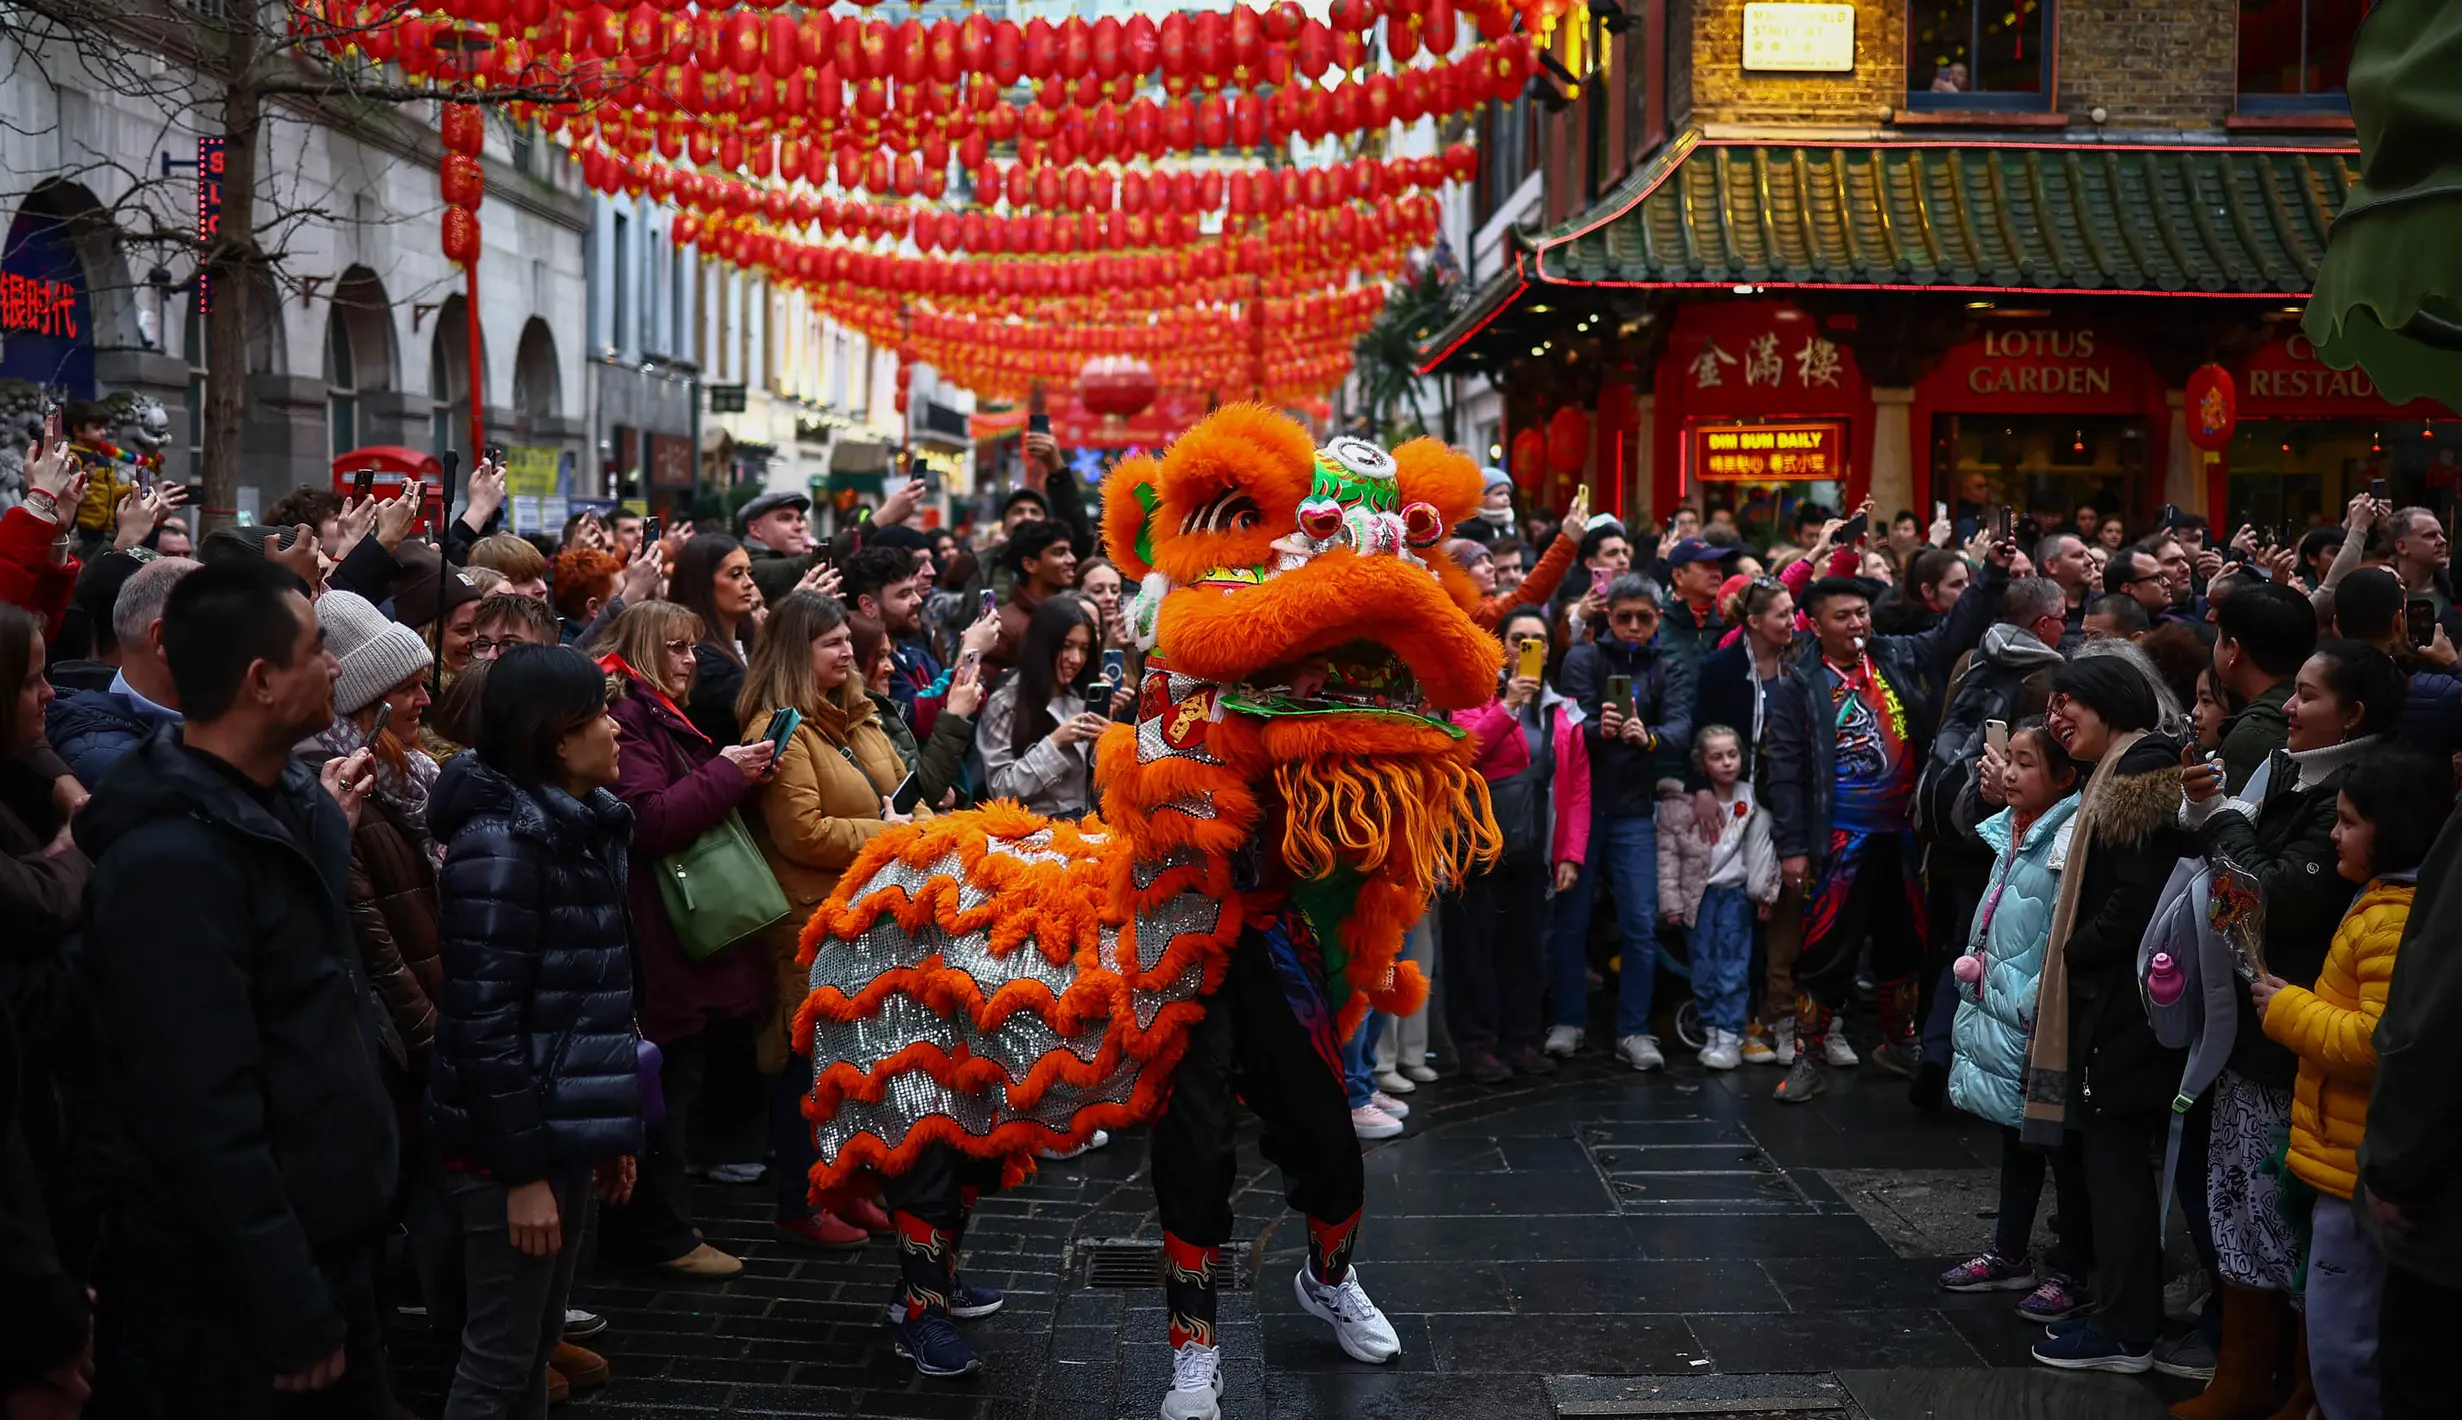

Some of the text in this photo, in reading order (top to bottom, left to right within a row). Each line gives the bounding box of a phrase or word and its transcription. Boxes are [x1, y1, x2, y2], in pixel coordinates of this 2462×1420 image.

[1985, 329, 2095, 358] LOTUS
[1968, 365, 2111, 394] GARDEN
[1709, 431, 1823, 449] DIM SUM DAILY
